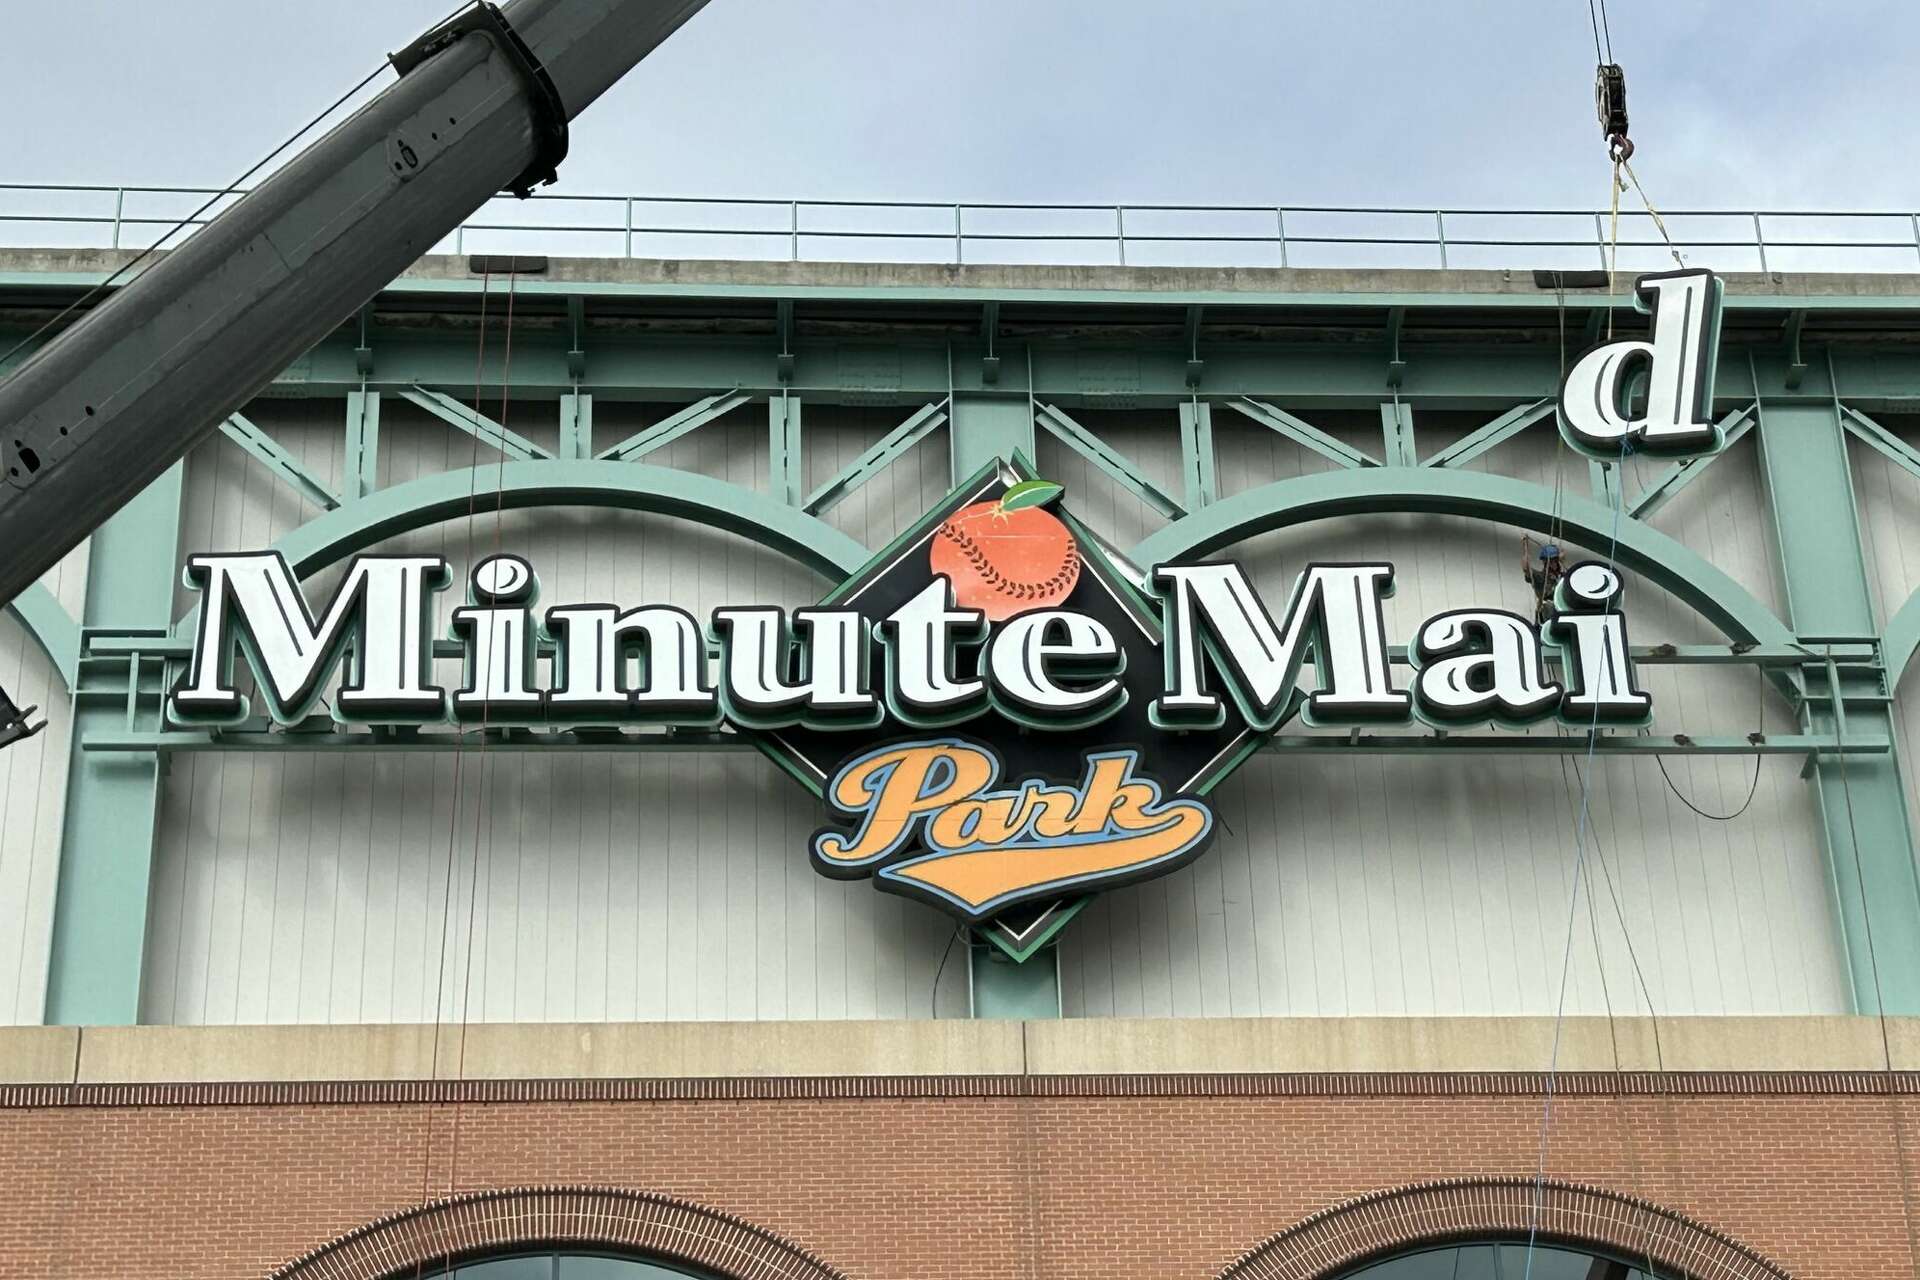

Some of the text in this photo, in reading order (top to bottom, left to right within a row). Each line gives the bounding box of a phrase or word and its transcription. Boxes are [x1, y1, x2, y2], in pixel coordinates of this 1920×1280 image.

[1558, 269, 1714, 447] d
[174, 551, 1650, 717] Minute Mai
[815, 738, 1212, 872] Park
